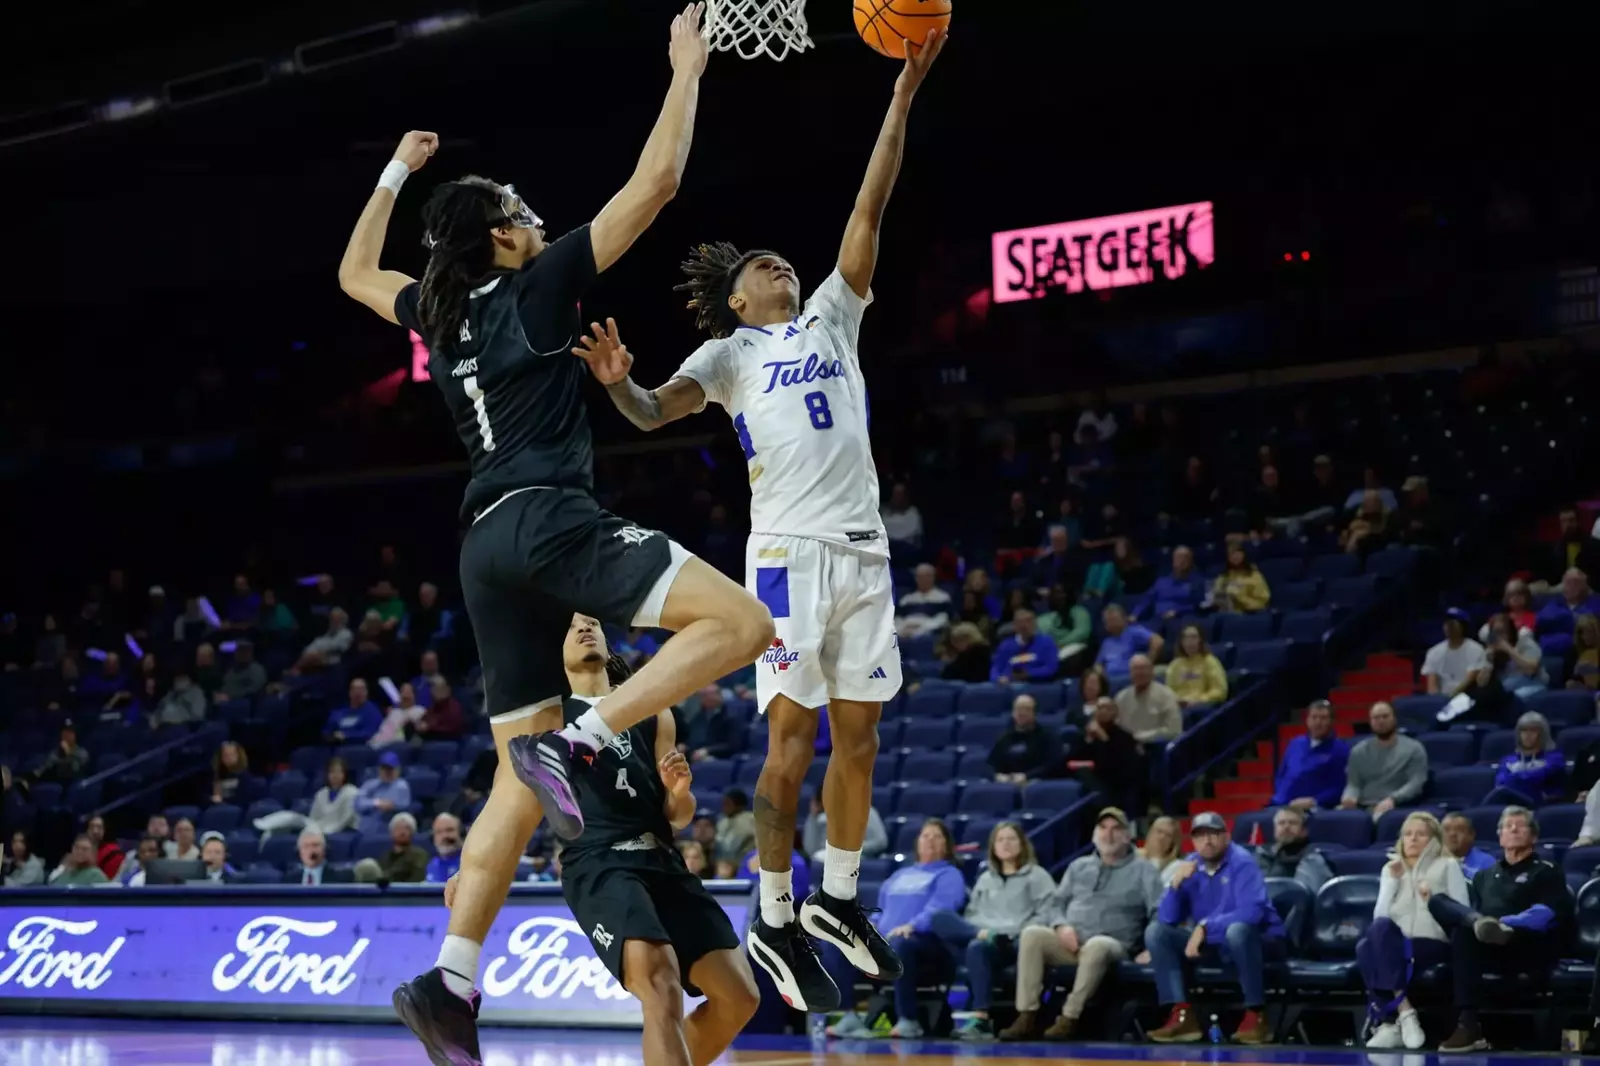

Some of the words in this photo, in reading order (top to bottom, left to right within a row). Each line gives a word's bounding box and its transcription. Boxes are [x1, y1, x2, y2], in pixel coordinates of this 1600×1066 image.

[1007, 210, 1197, 292] SEATGEEK
[762, 352, 844, 394] Tulsa
[804, 391, 834, 430] 8
[463, 375, 496, 452] 1
[615, 767, 637, 798] 4
[0, 915, 126, 991] Ford
[211, 915, 371, 995] Ford
[483, 916, 634, 1001] For
